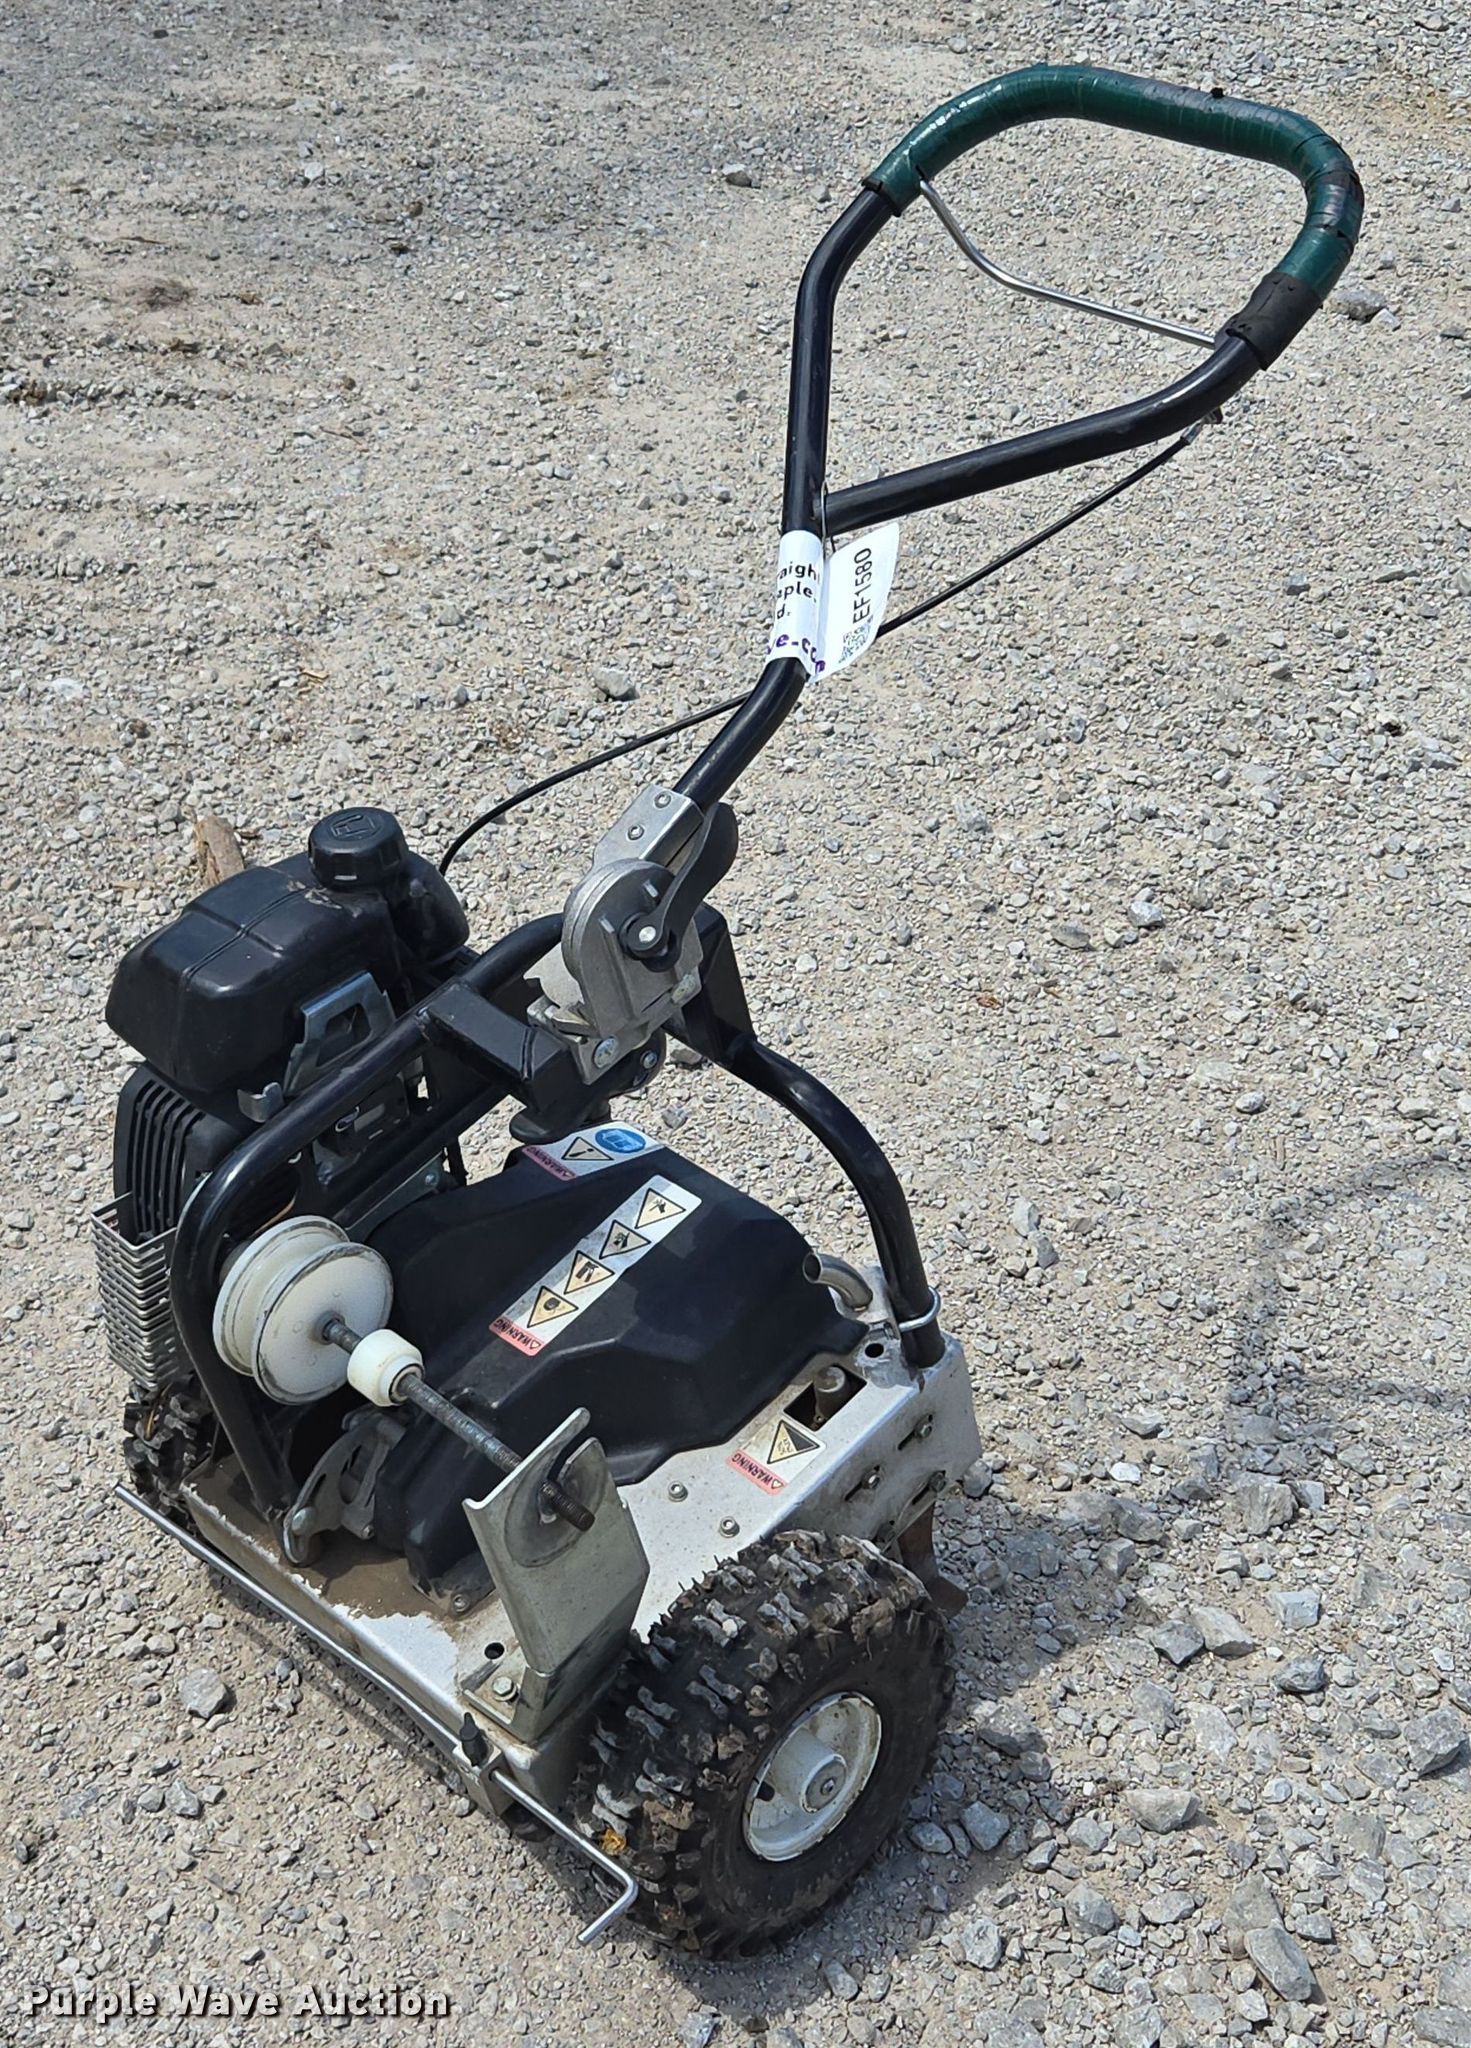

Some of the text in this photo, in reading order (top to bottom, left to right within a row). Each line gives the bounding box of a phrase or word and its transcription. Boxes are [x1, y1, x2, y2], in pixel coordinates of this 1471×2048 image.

[853, 547, 873, 624] EF1580
[493, 1318, 532, 1346] WARNING
[731, 1452, 773, 1485] WARNING
